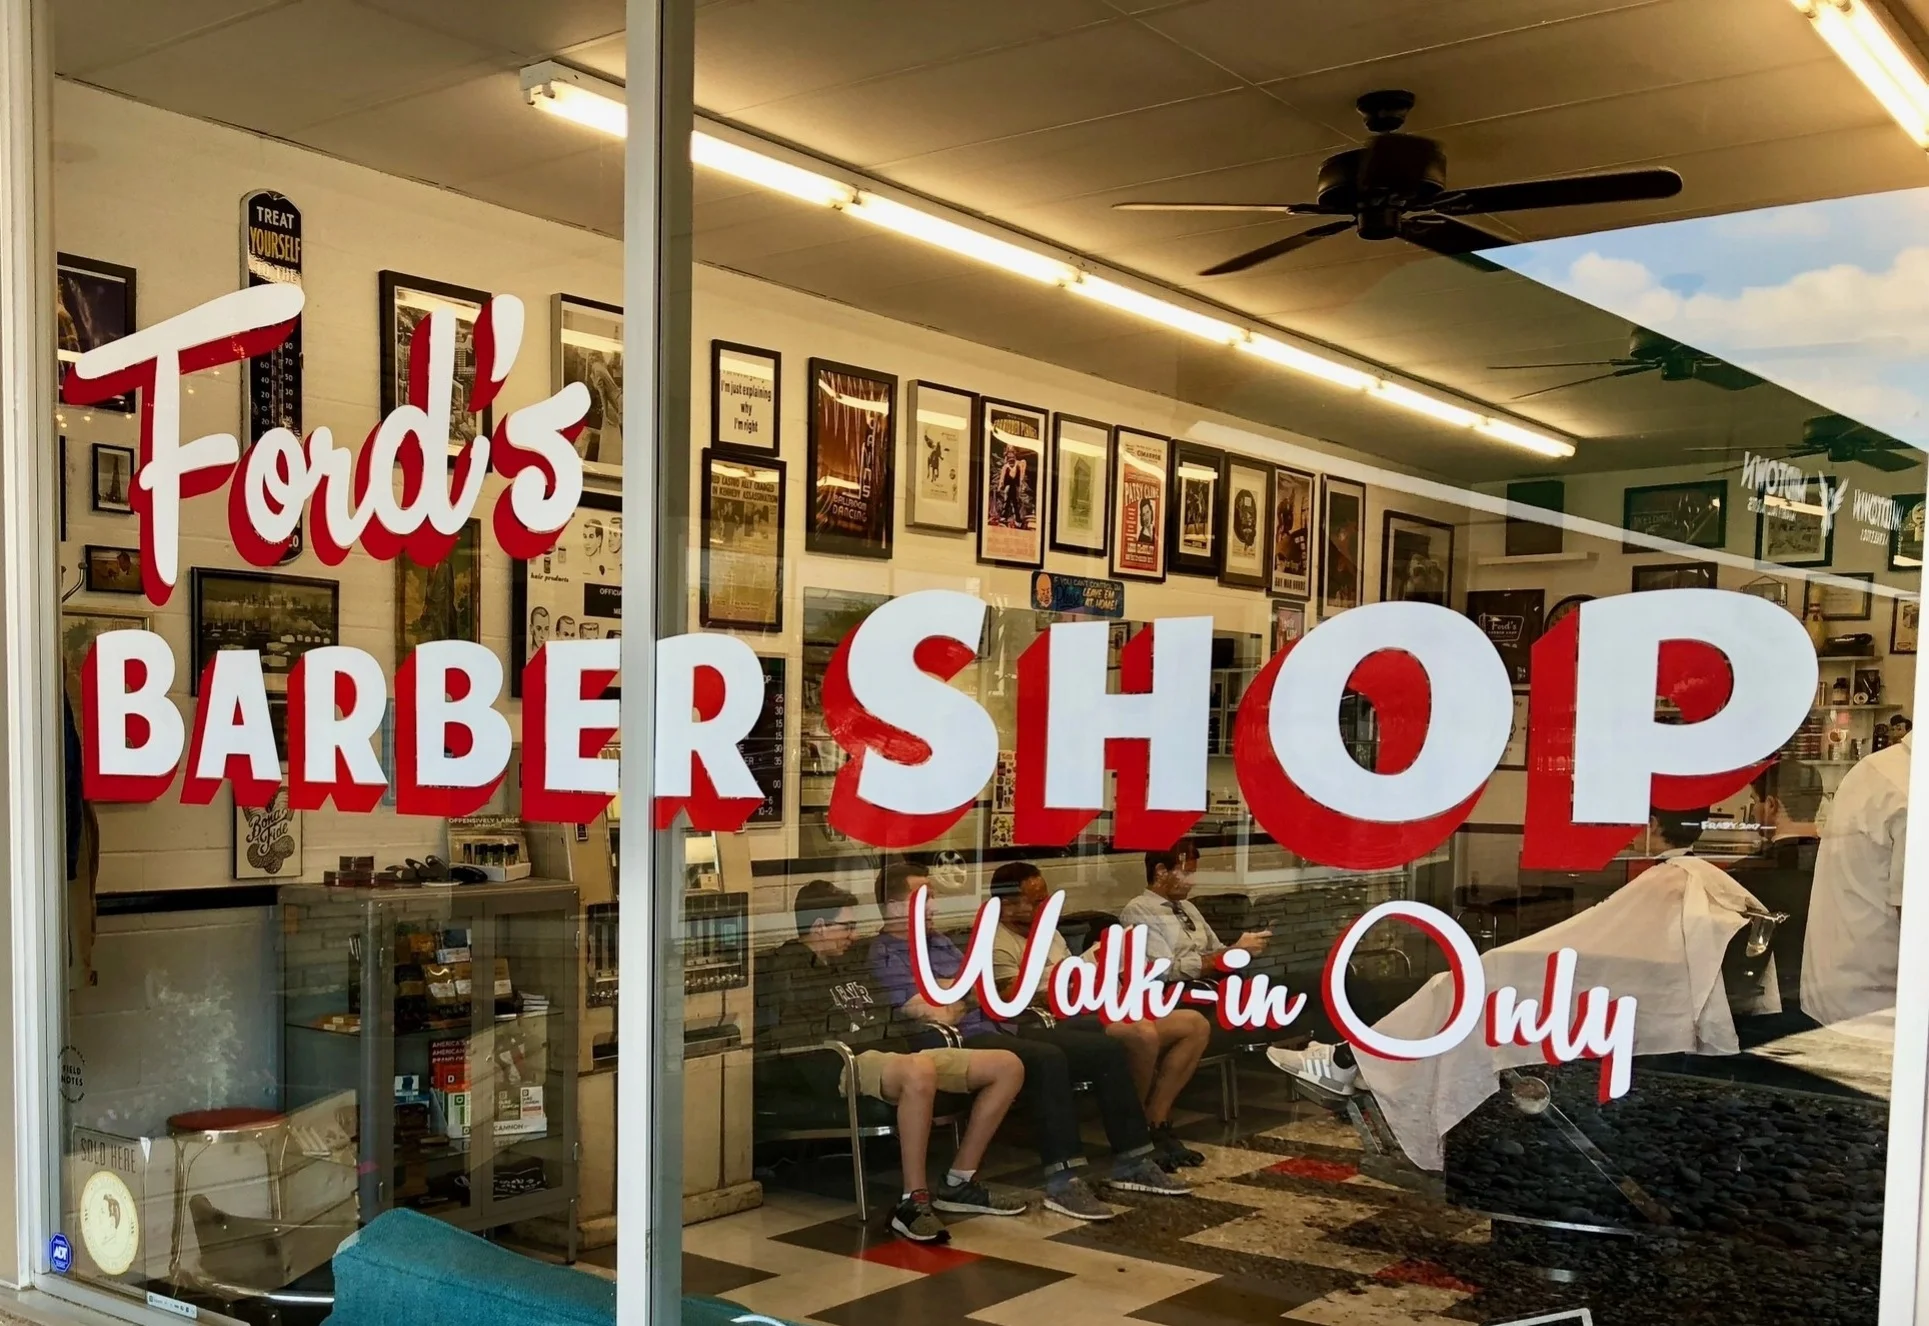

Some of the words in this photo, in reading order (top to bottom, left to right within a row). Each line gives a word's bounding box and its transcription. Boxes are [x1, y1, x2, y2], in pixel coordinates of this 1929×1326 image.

[256, 205, 295, 229] TREAT
[249, 226, 301, 263] YOURSELF
[274, 264, 298, 283] THE
[720, 380, 731, 393] I'm
[731, 381, 742, 396] just
[742, 385, 772, 402] explaining
[740, 401, 752, 417] why
[733, 417, 744, 430] I'm
[744, 419, 758, 435] right
[62, 282, 592, 607] Ford's
[832, 504, 868, 522] DANCING
[530, 572, 544, 580] hair
[544, 575, 569, 583] products
[599, 588, 622, 597] OFFICIA
[1082, 587, 1103, 599] LEAVE
[1095, 599, 1119, 611] HOME!
[775, 706, 784, 715] 30
[80, 629, 767, 834] BARBER
[775, 719, 783, 728] 15
[823, 587, 1819, 870] SHOP
[758, 806, 773, 816] 10-2
[246, 808, 288, 843] Bona
[260, 822, 288, 854] Fide
[908, 884, 1307, 1031] Walk-in
[1321, 900, 1637, 1105] Only
[62, 1064, 82, 1076] FIELD
[447, 1075, 455, 1083] D
[61, 1075, 84, 1087] NOTES
[80, 1137, 106, 1167] SOLD
[110, 1143, 137, 1174] HERE
[53, 1245, 68, 1261] ADT
